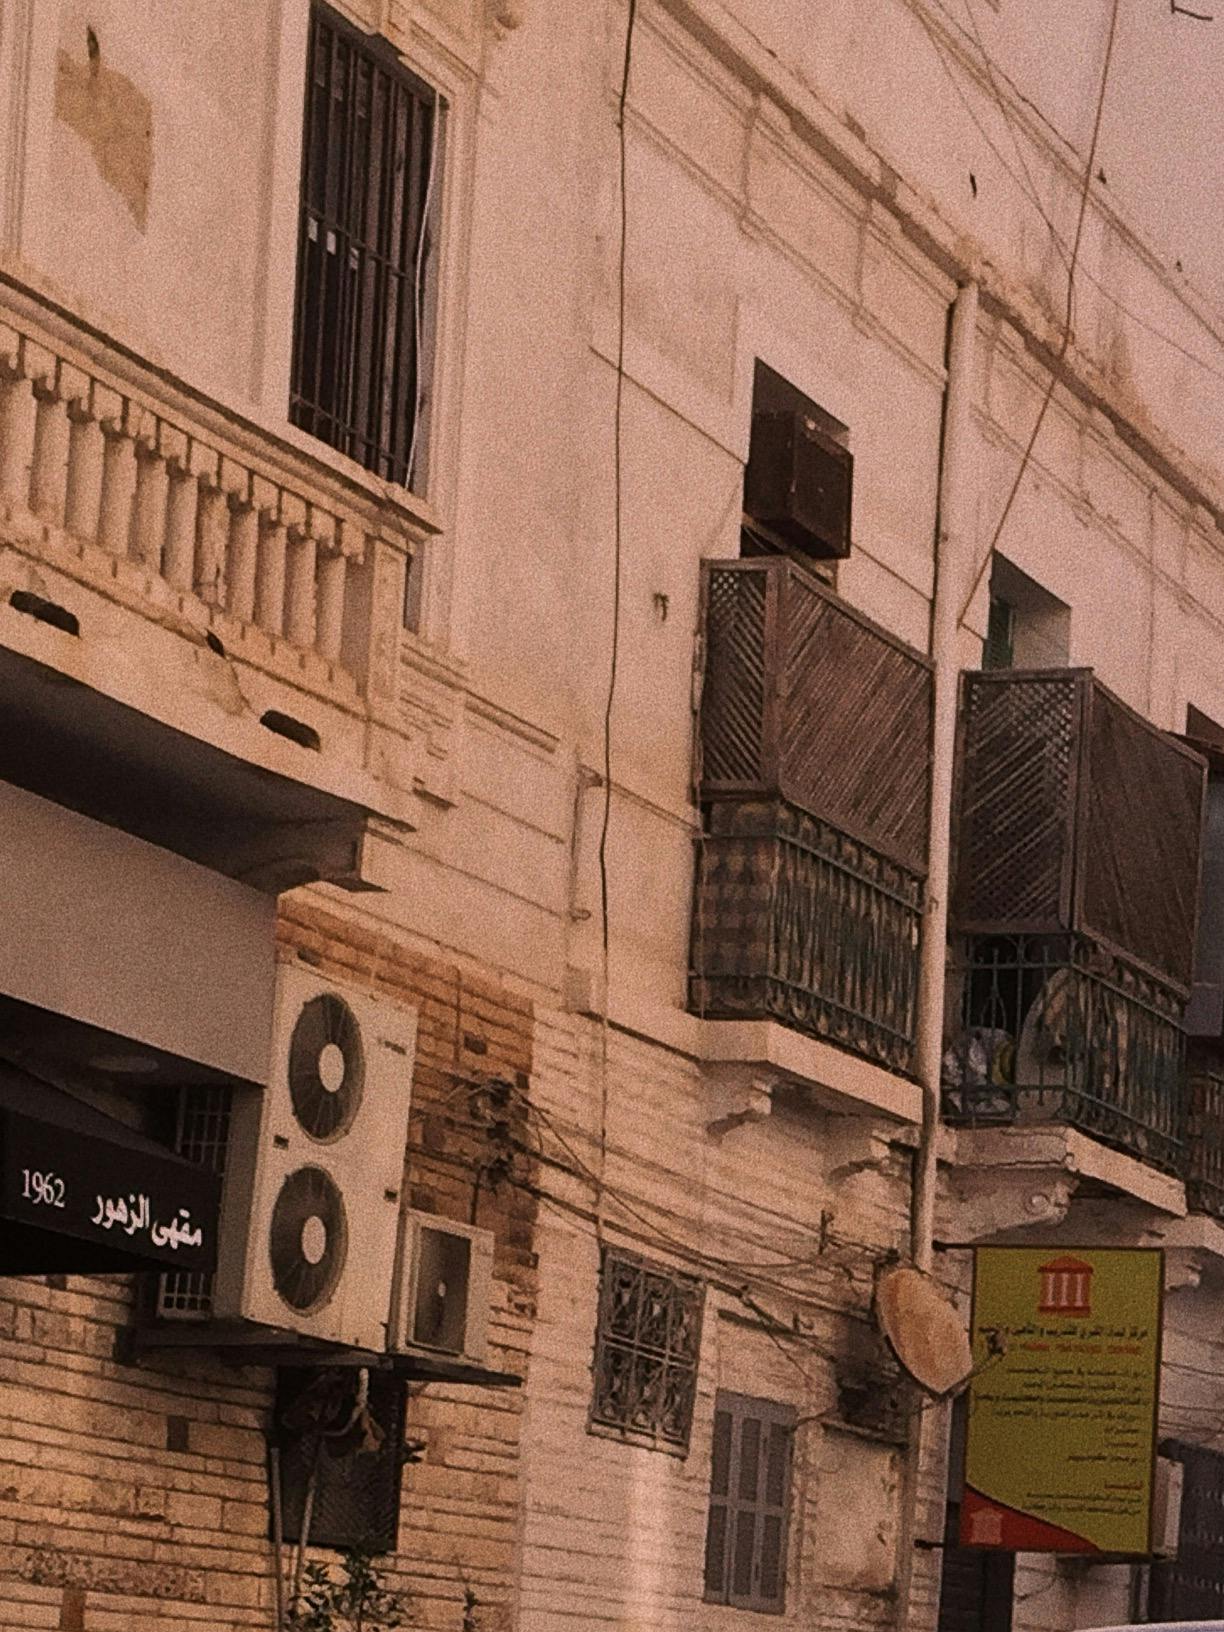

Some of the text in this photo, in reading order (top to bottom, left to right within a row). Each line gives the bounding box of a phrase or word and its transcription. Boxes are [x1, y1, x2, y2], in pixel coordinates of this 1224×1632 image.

[21, 1169, 66, 1208] 1962
[90, 1194, 202, 1250] مقهى الزهور
